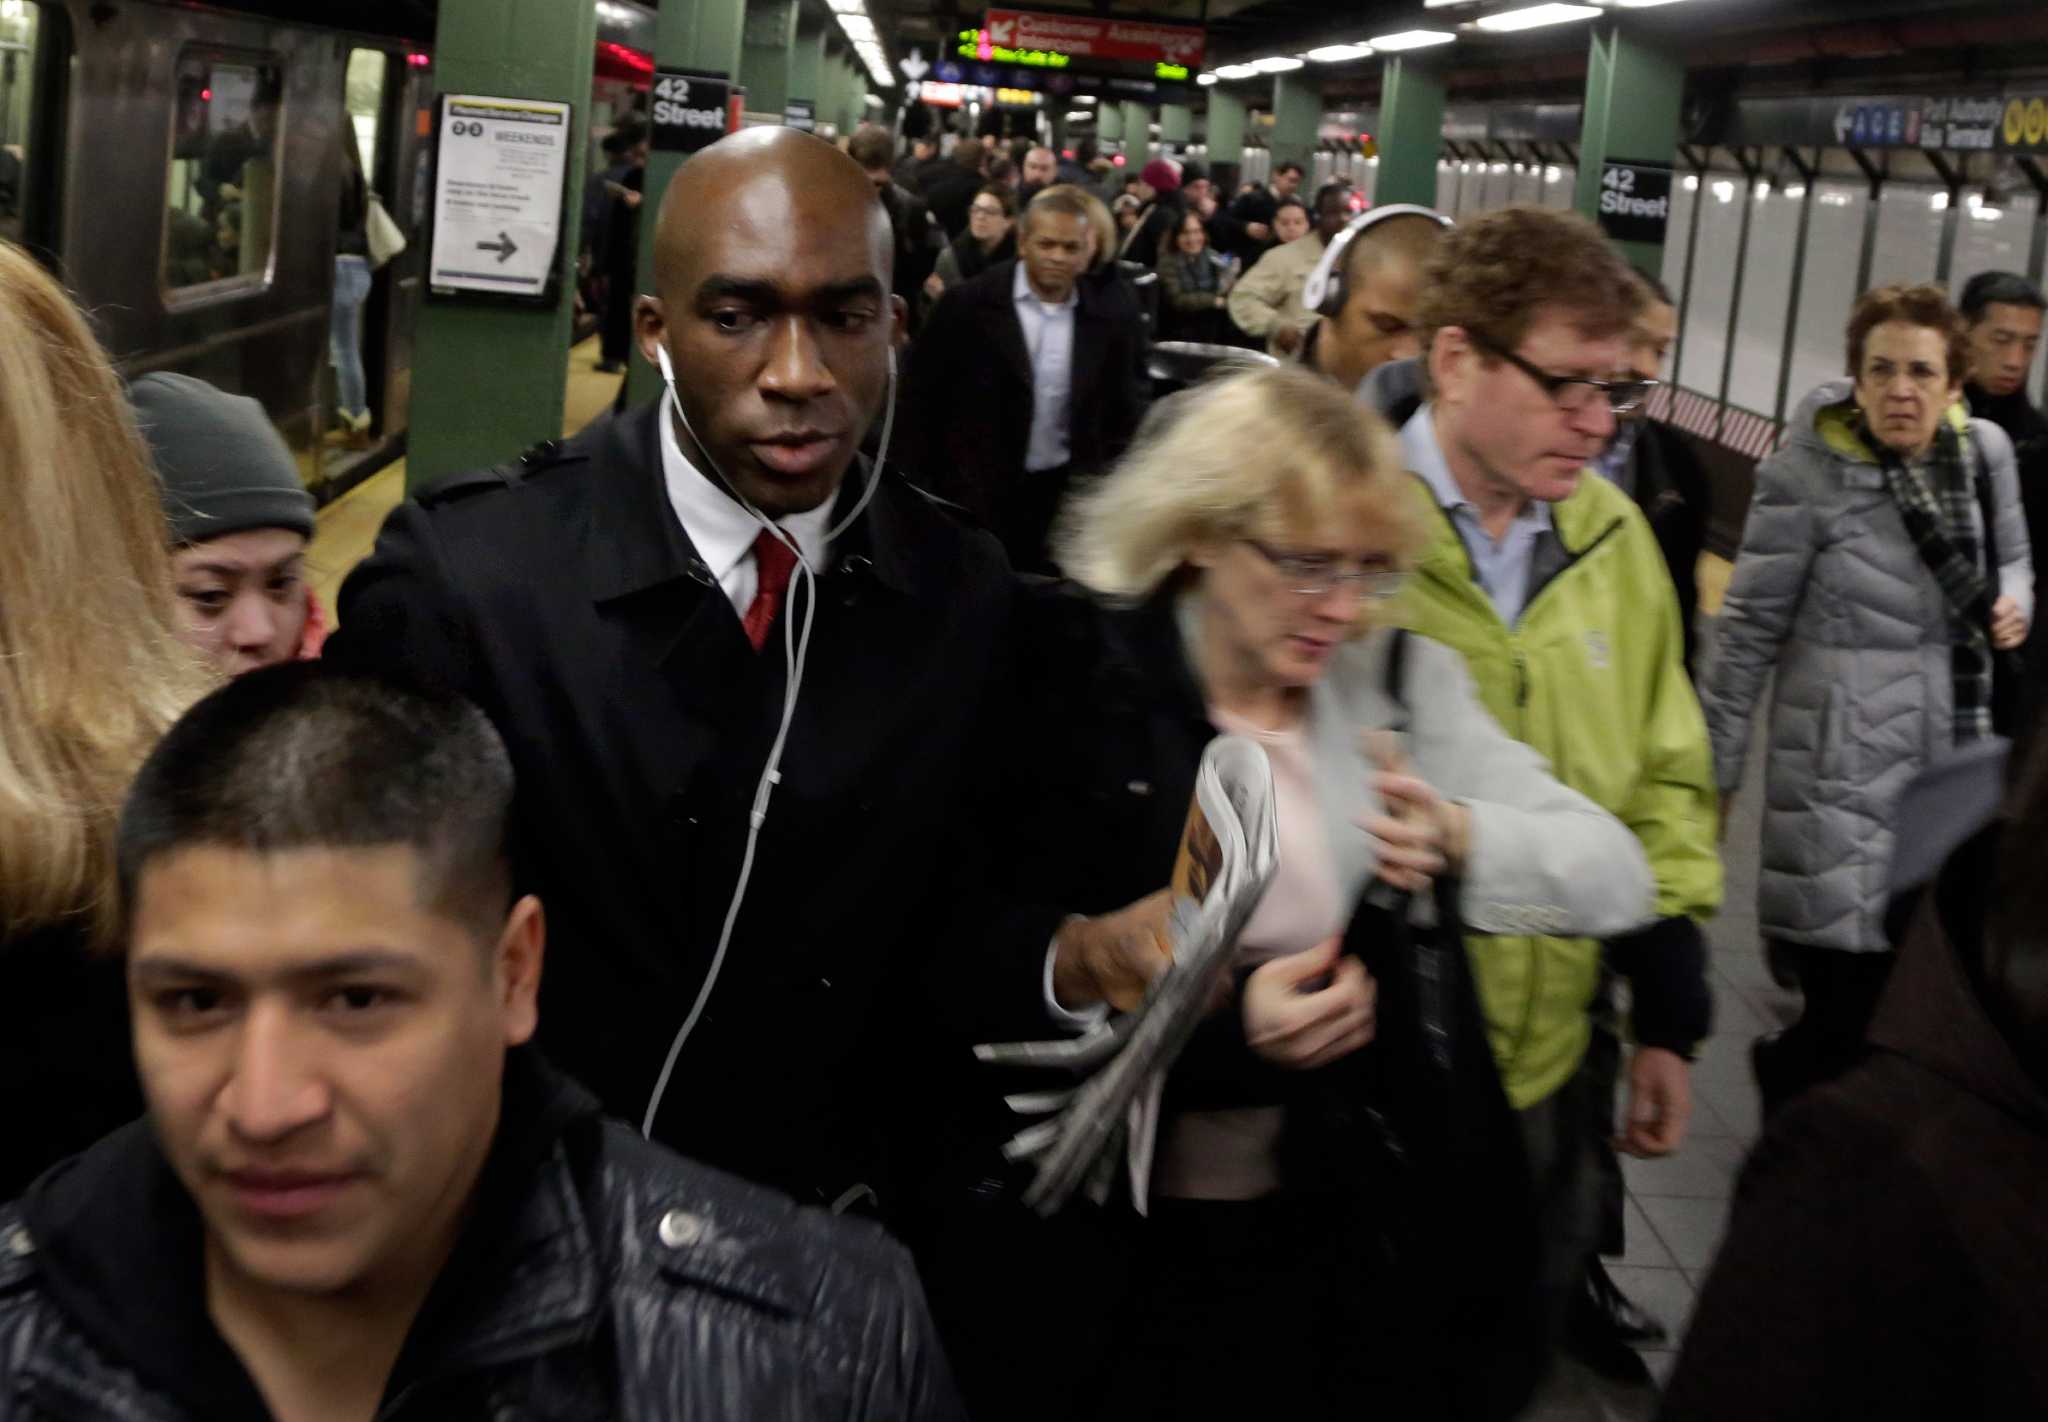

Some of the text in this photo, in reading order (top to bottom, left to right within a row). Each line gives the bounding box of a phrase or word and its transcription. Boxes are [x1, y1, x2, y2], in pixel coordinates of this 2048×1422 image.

[1018, 15, 1101, 37] Customer
[655, 78, 690, 101] 42
[653, 101, 725, 128] Street
[1603, 167, 1635, 192] 42
[1601, 190, 1666, 218] Street
